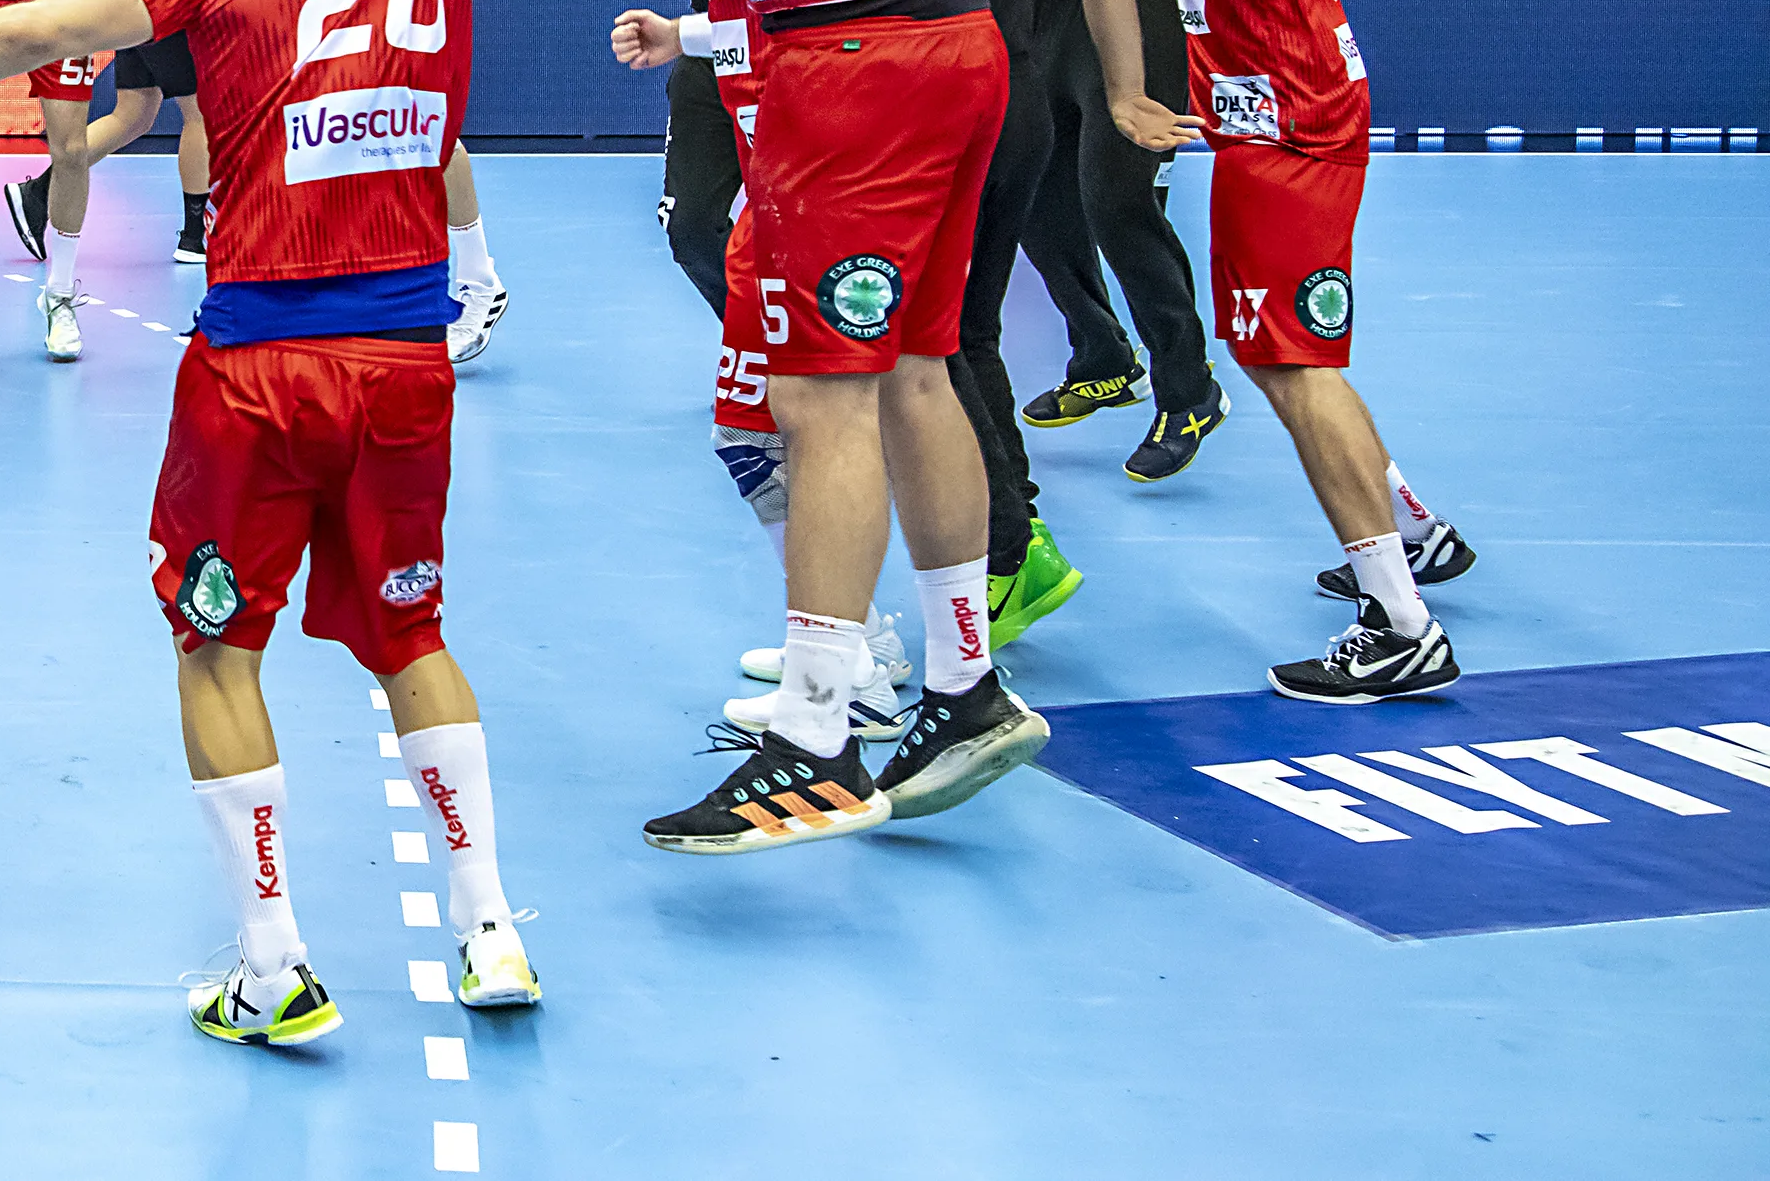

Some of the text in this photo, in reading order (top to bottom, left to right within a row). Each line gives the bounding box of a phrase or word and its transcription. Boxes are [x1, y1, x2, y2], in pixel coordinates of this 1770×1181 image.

[1227, 113, 1275, 124] LASS
[829, 257, 897, 279] EXE GREEN
[1305, 272, 1323, 288] EXE
[716, 344, 769, 406] 25
[957, 596, 984, 662] Kempa
[421, 766, 472, 852] Kempa
[1191, 735, 1731, 843] FLYT
[254, 805, 282, 900] Kempa
